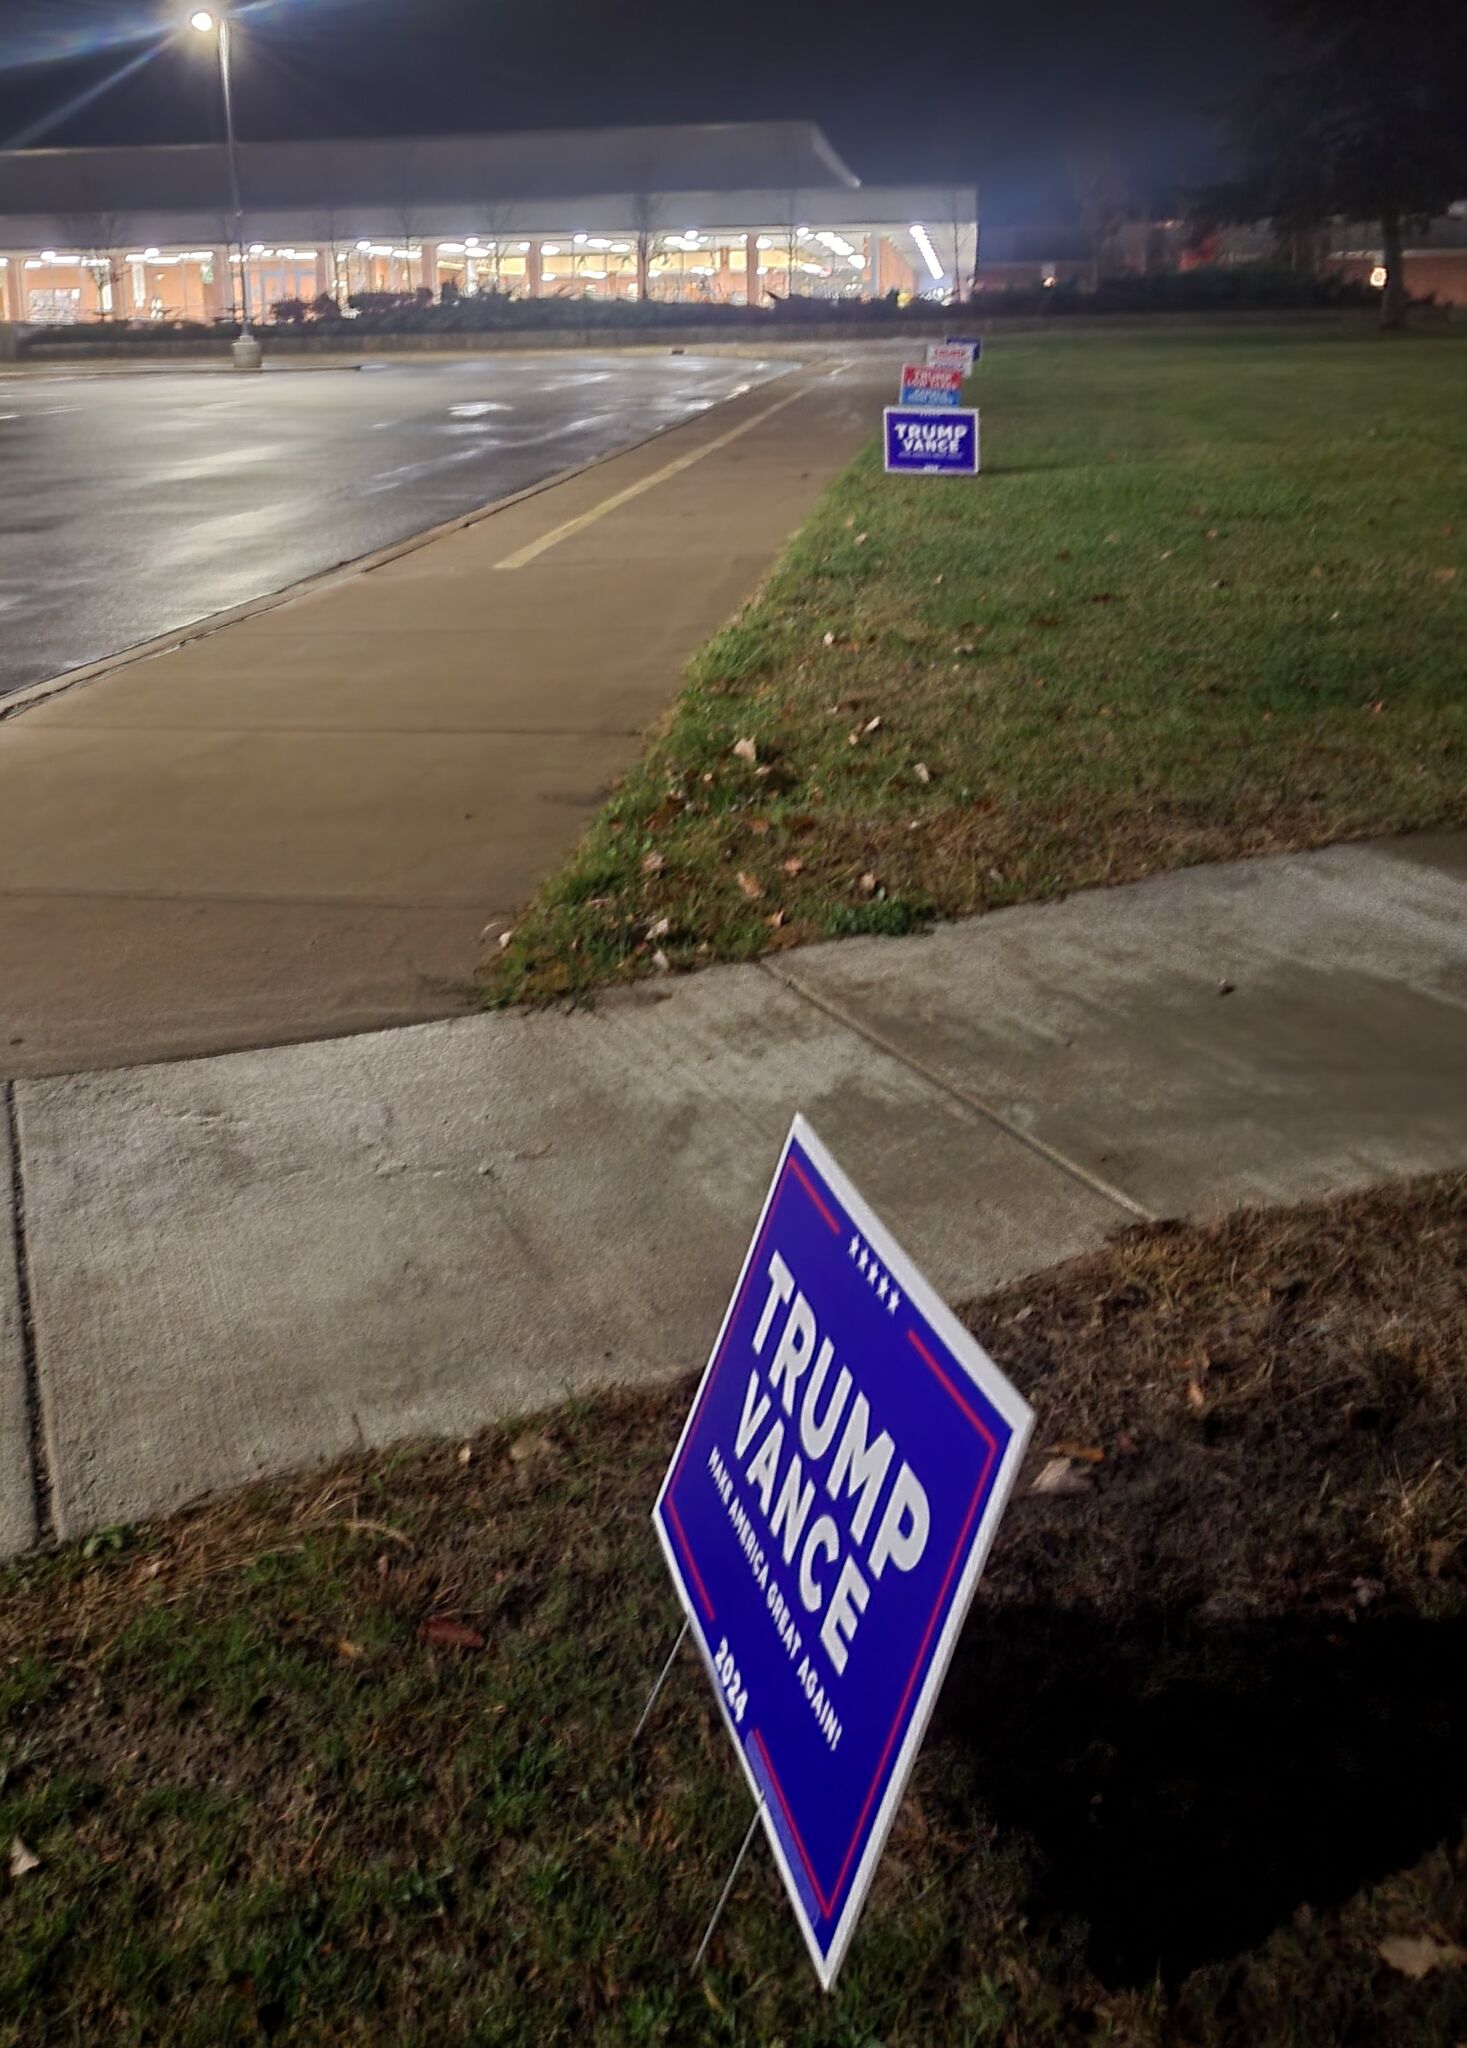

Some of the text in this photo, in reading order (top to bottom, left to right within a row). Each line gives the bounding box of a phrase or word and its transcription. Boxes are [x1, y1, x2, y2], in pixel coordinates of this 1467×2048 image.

[895, 424, 967, 440] TRUMP
[903, 438, 958, 453] VANCE
[752, 1250, 930, 1581] TRUMP
[707, 1446, 842, 1752] MAKE AMERICA GREAT AGAIN!
[734, 1370, 871, 1676] VANCE
[715, 1635, 748, 1723] 2024
